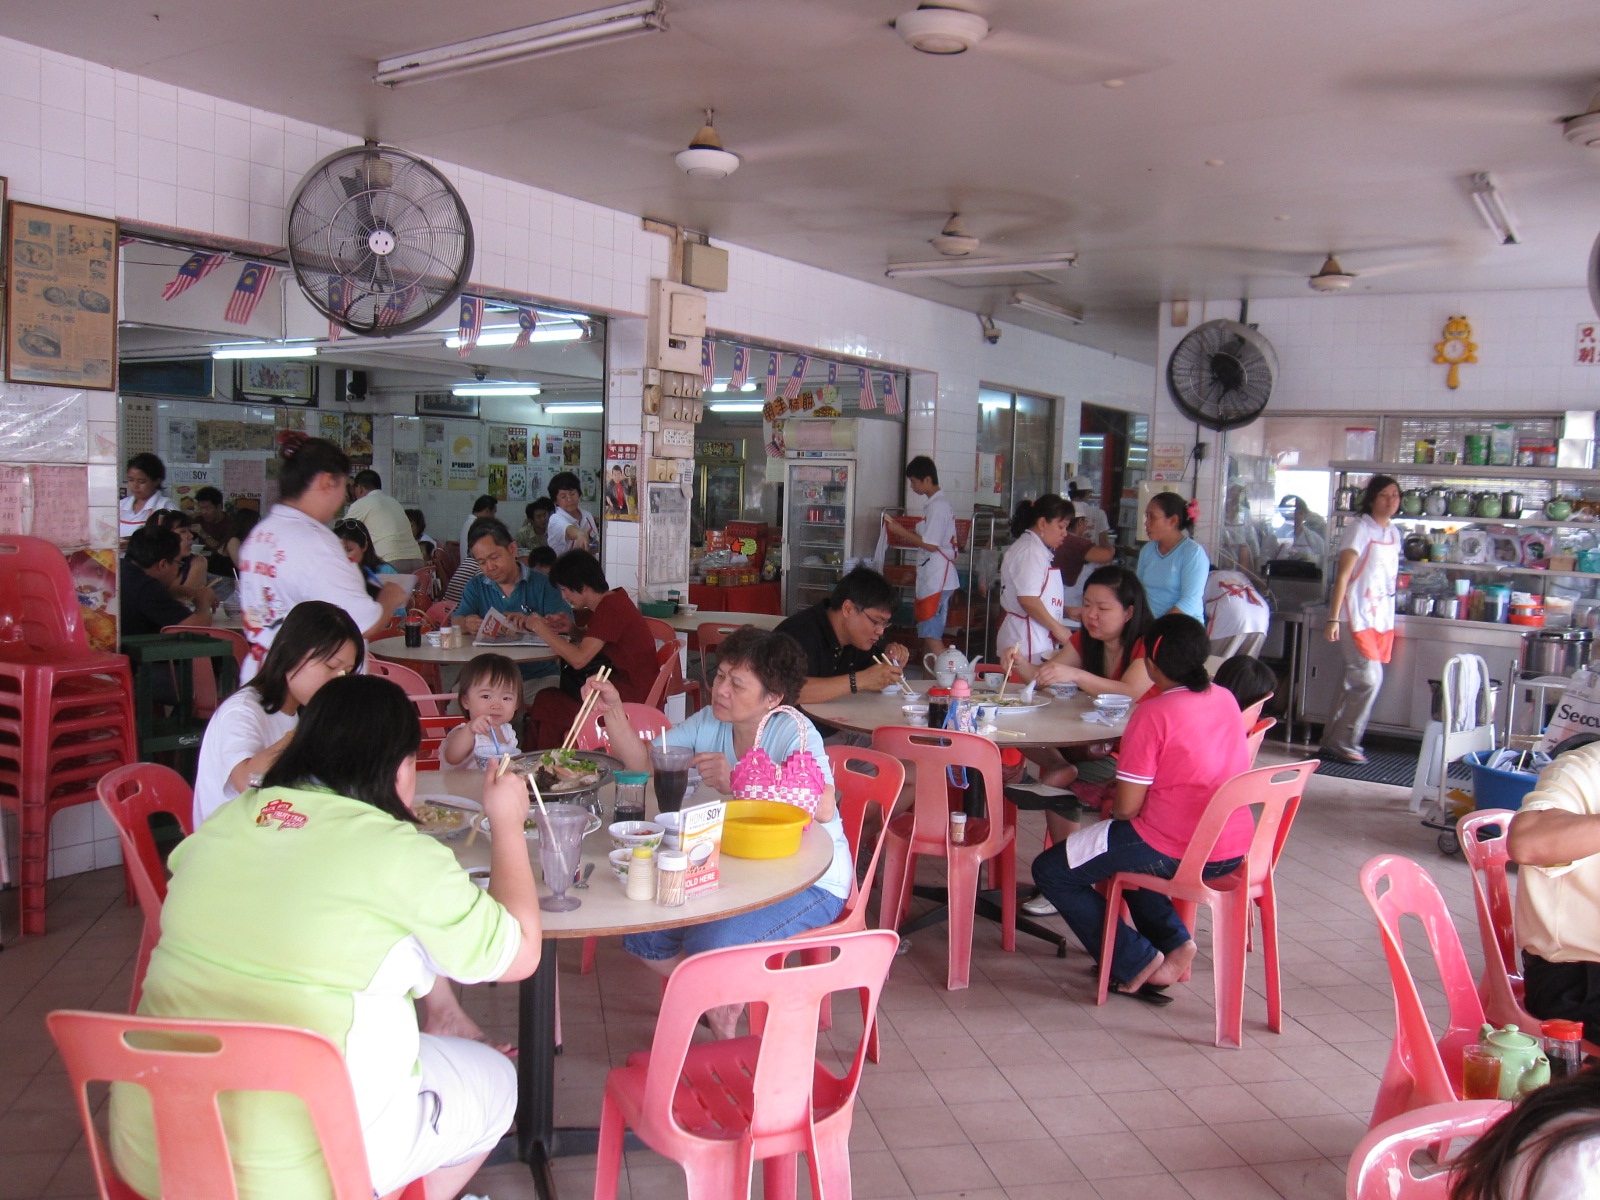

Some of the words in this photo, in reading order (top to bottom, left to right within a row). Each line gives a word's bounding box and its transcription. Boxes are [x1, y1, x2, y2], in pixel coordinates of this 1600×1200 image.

[174, 470, 207, 480] HOMESOY
[685, 877, 699, 889] OLD
[699, 871, 716, 884] HERE
